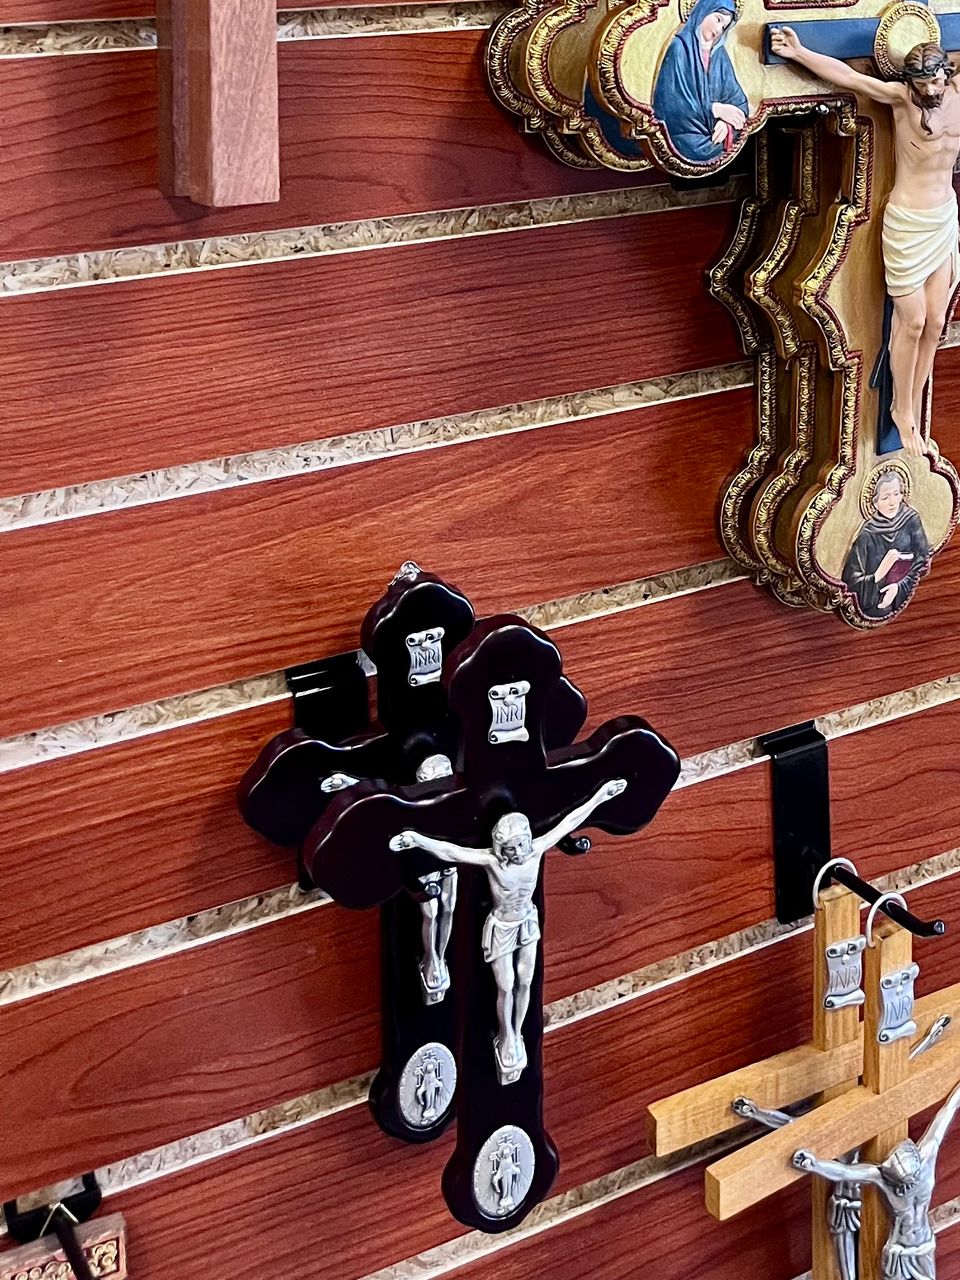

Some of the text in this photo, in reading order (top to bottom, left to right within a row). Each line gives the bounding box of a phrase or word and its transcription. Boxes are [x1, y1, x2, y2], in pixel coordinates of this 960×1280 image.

[413, 648, 441, 669] INRI
[496, 702, 524, 724] INRI
[829, 964, 862, 993] INRI
[884, 995, 912, 1026] INR
